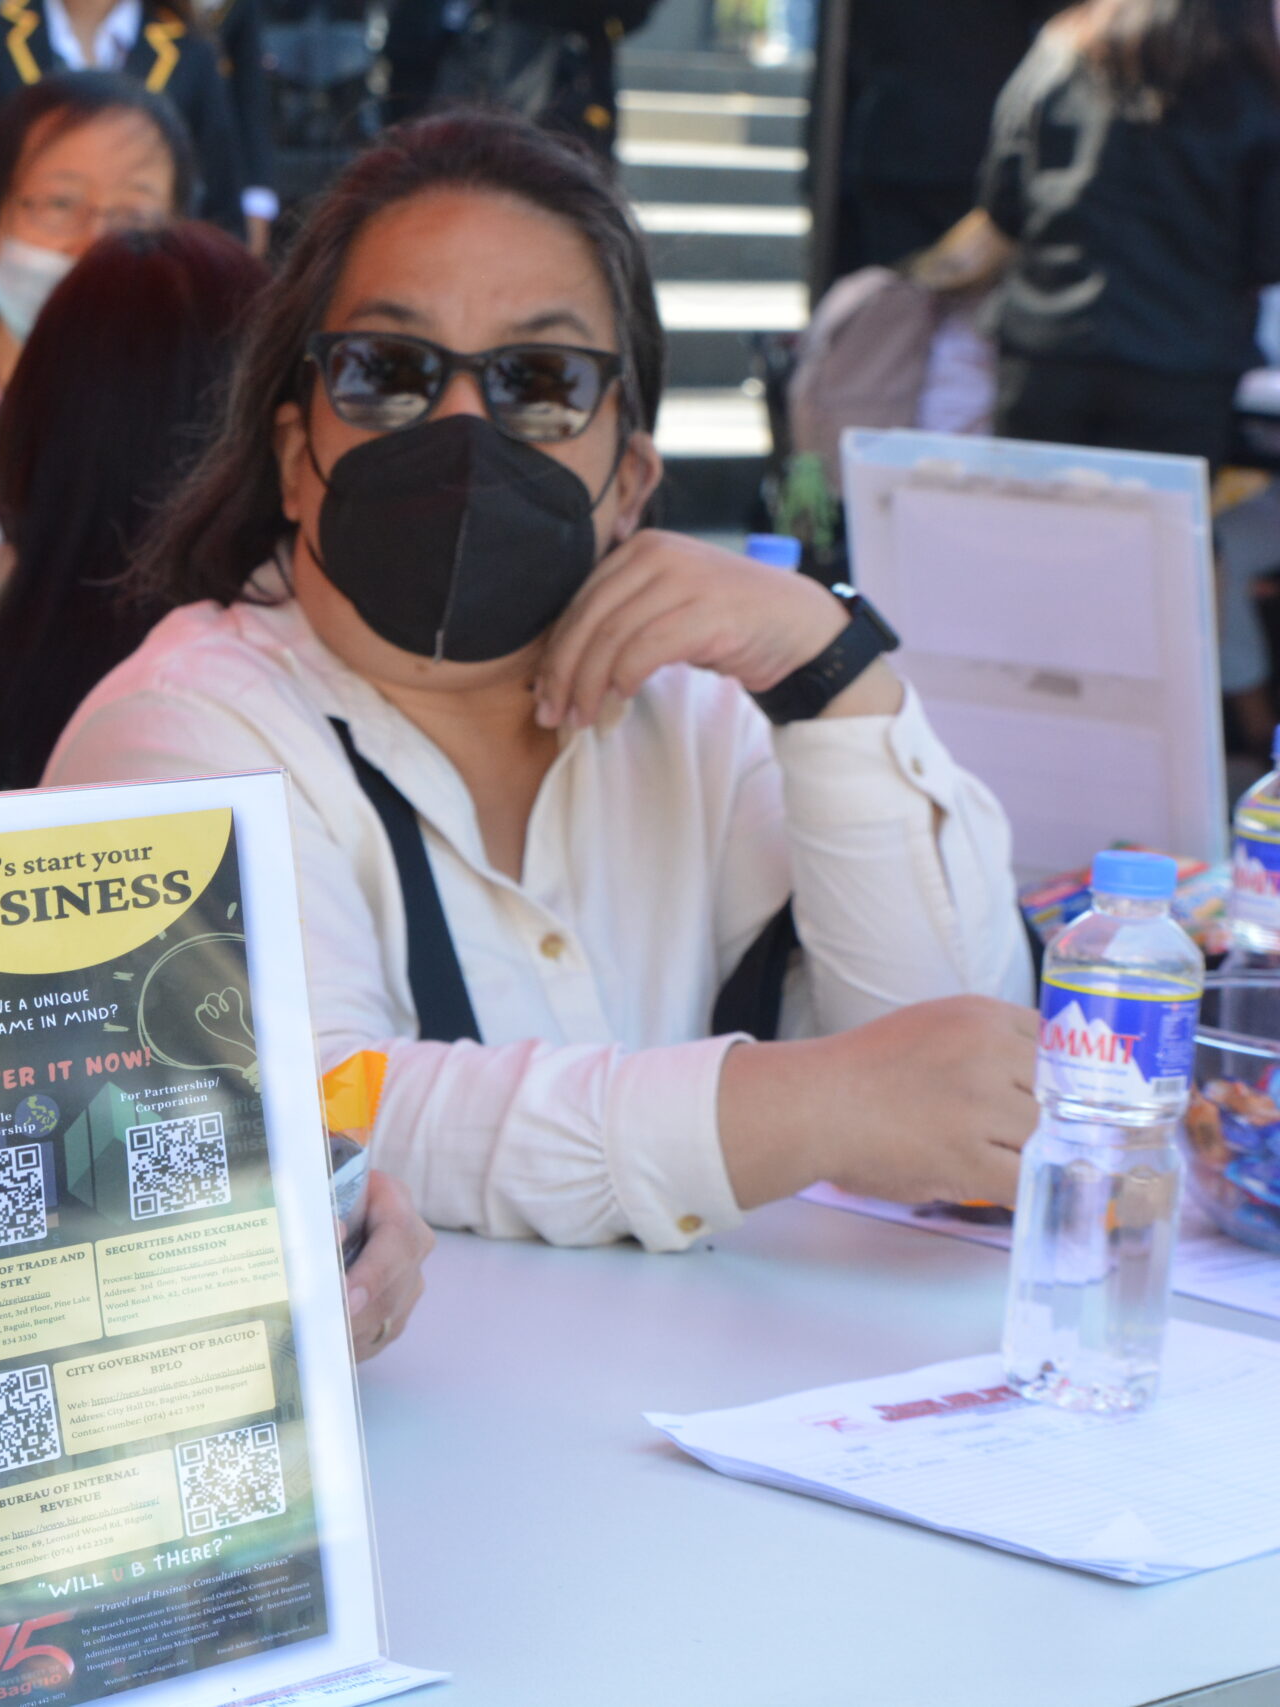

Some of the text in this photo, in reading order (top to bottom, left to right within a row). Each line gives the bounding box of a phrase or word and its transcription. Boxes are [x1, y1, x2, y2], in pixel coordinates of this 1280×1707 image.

[22, 848, 86, 875] start
[90, 841, 153, 867] your
[17, 996, 27, 1011] A
[33, 987, 90, 1009] UNIQUE
[40, 1013, 56, 1029] IN
[62, 1003, 119, 1026] MIND?
[1038, 1019, 1141, 1065] UMMIT
[47, 1058, 74, 1082] IT
[84, 1046, 153, 1076] NOW!
[119, 1076, 220, 1103] For Partnership/
[135, 1092, 208, 1115] Corporation
[105, 1216, 268, 1256] SECURITIES AND EXCHANGE
[21, 1256, 57, 1272] TRADE
[60, 1250, 85, 1264] AND
[148, 1238, 226, 1262] COMMISSION
[102, 1272, 133, 1287] Process:
[103, 1285, 136, 1299] Address:
[14, 1307, 28, 1317] 3rd
[30, 1302, 53, 1314] Floor,
[53, 1298, 70, 1309] Pine
[72, 1294, 90, 1305] Lake
[3, 1319, 32, 1334] Baguio,
[33, 1313, 65, 1328] Benguet
[65, 1327, 260, 1378] CITY GOVERNMENT OF BAGUIO-
[150, 1359, 182, 1375] BPLO
[67, 1398, 90, 1413] Web:
[68, 1410, 105, 1427] Address:
[106, 1406, 123, 1418] City
[125, 1401, 143, 1414] Hall
[71, 1424, 105, 1440] Contact
[106, 1416, 141, 1432] number:
[143, 1410, 165, 1423] (074)
[54, 1482, 70, 1495] OF
[73, 1466, 139, 1490] INTERNAL
[39, 1490, 101, 1514] REVENUE
[16, 1542, 30, 1553] No.
[31, 1538, 44, 1549] 69,
[46, 1529, 79, 1546] Leonard
[81, 1522, 107, 1537] Wood
[124, 1511, 153, 1526] Baguio
[15, 1551, 49, 1568] number:
[51, 1545, 73, 1558] (074)
[38, 1567, 104, 1602] "WILL
[111, 1562, 123, 1583] U
[130, 1556, 145, 1578] B
[131, 1590, 150, 1604] and
[152, 1579, 190, 1599] Business
[192, 1563, 250, 1588] Consultation
[81, 1573, 288, 1637] by Research Innovation Extension and Outreach Community
[92, 1626, 140, 1646] collaboration
[142, 1621, 158, 1632] with
[160, 1617, 172, 1627] the
[174, 1609, 201, 1623] Finance
[202, 1597, 246, 1615] Department,
[247, 1590, 270, 1603] School
[280, 1579, 309, 1594] Business
[85, 1638, 139, 1661] Administration
[143, 1634, 157, 1644] and
[212, 1615, 225, 1625] and
[228, 1607, 252, 1621] School
[267, 1591, 311, 1610] International
[86, 1629, 219, 1673] Hospitality and Tourism Management
